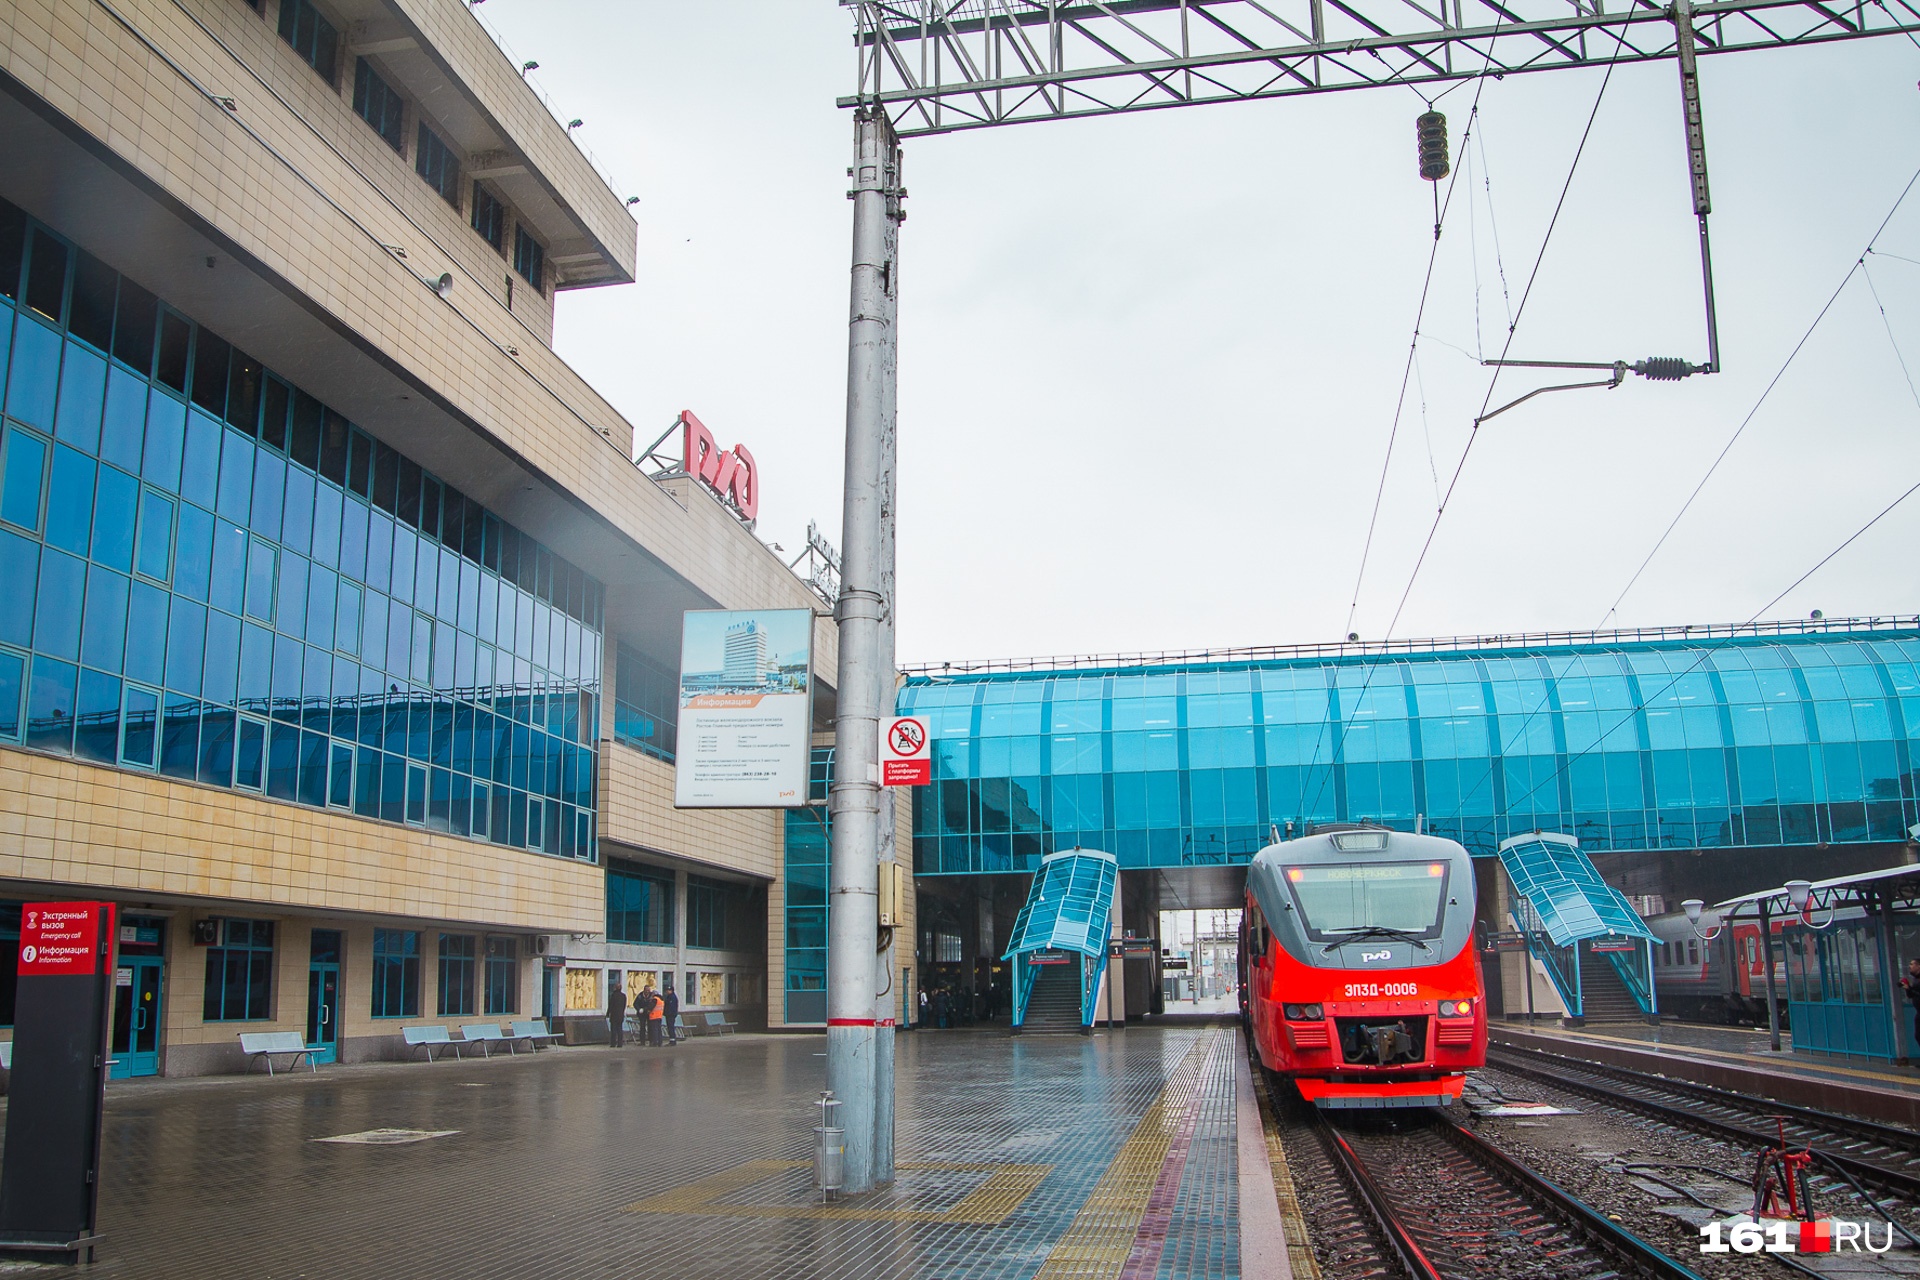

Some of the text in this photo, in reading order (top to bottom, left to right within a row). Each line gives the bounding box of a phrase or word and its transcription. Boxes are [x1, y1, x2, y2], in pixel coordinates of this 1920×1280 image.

[696, 698, 752, 706] Информация
[42, 910, 88, 921] Экстренный
[40, 932, 70, 940] Emergency
[39, 946, 89, 956] Информация
[1361, 950, 1391, 963] РЖД
[1344, 983, 1418, 998] ЭП3Д-0006
